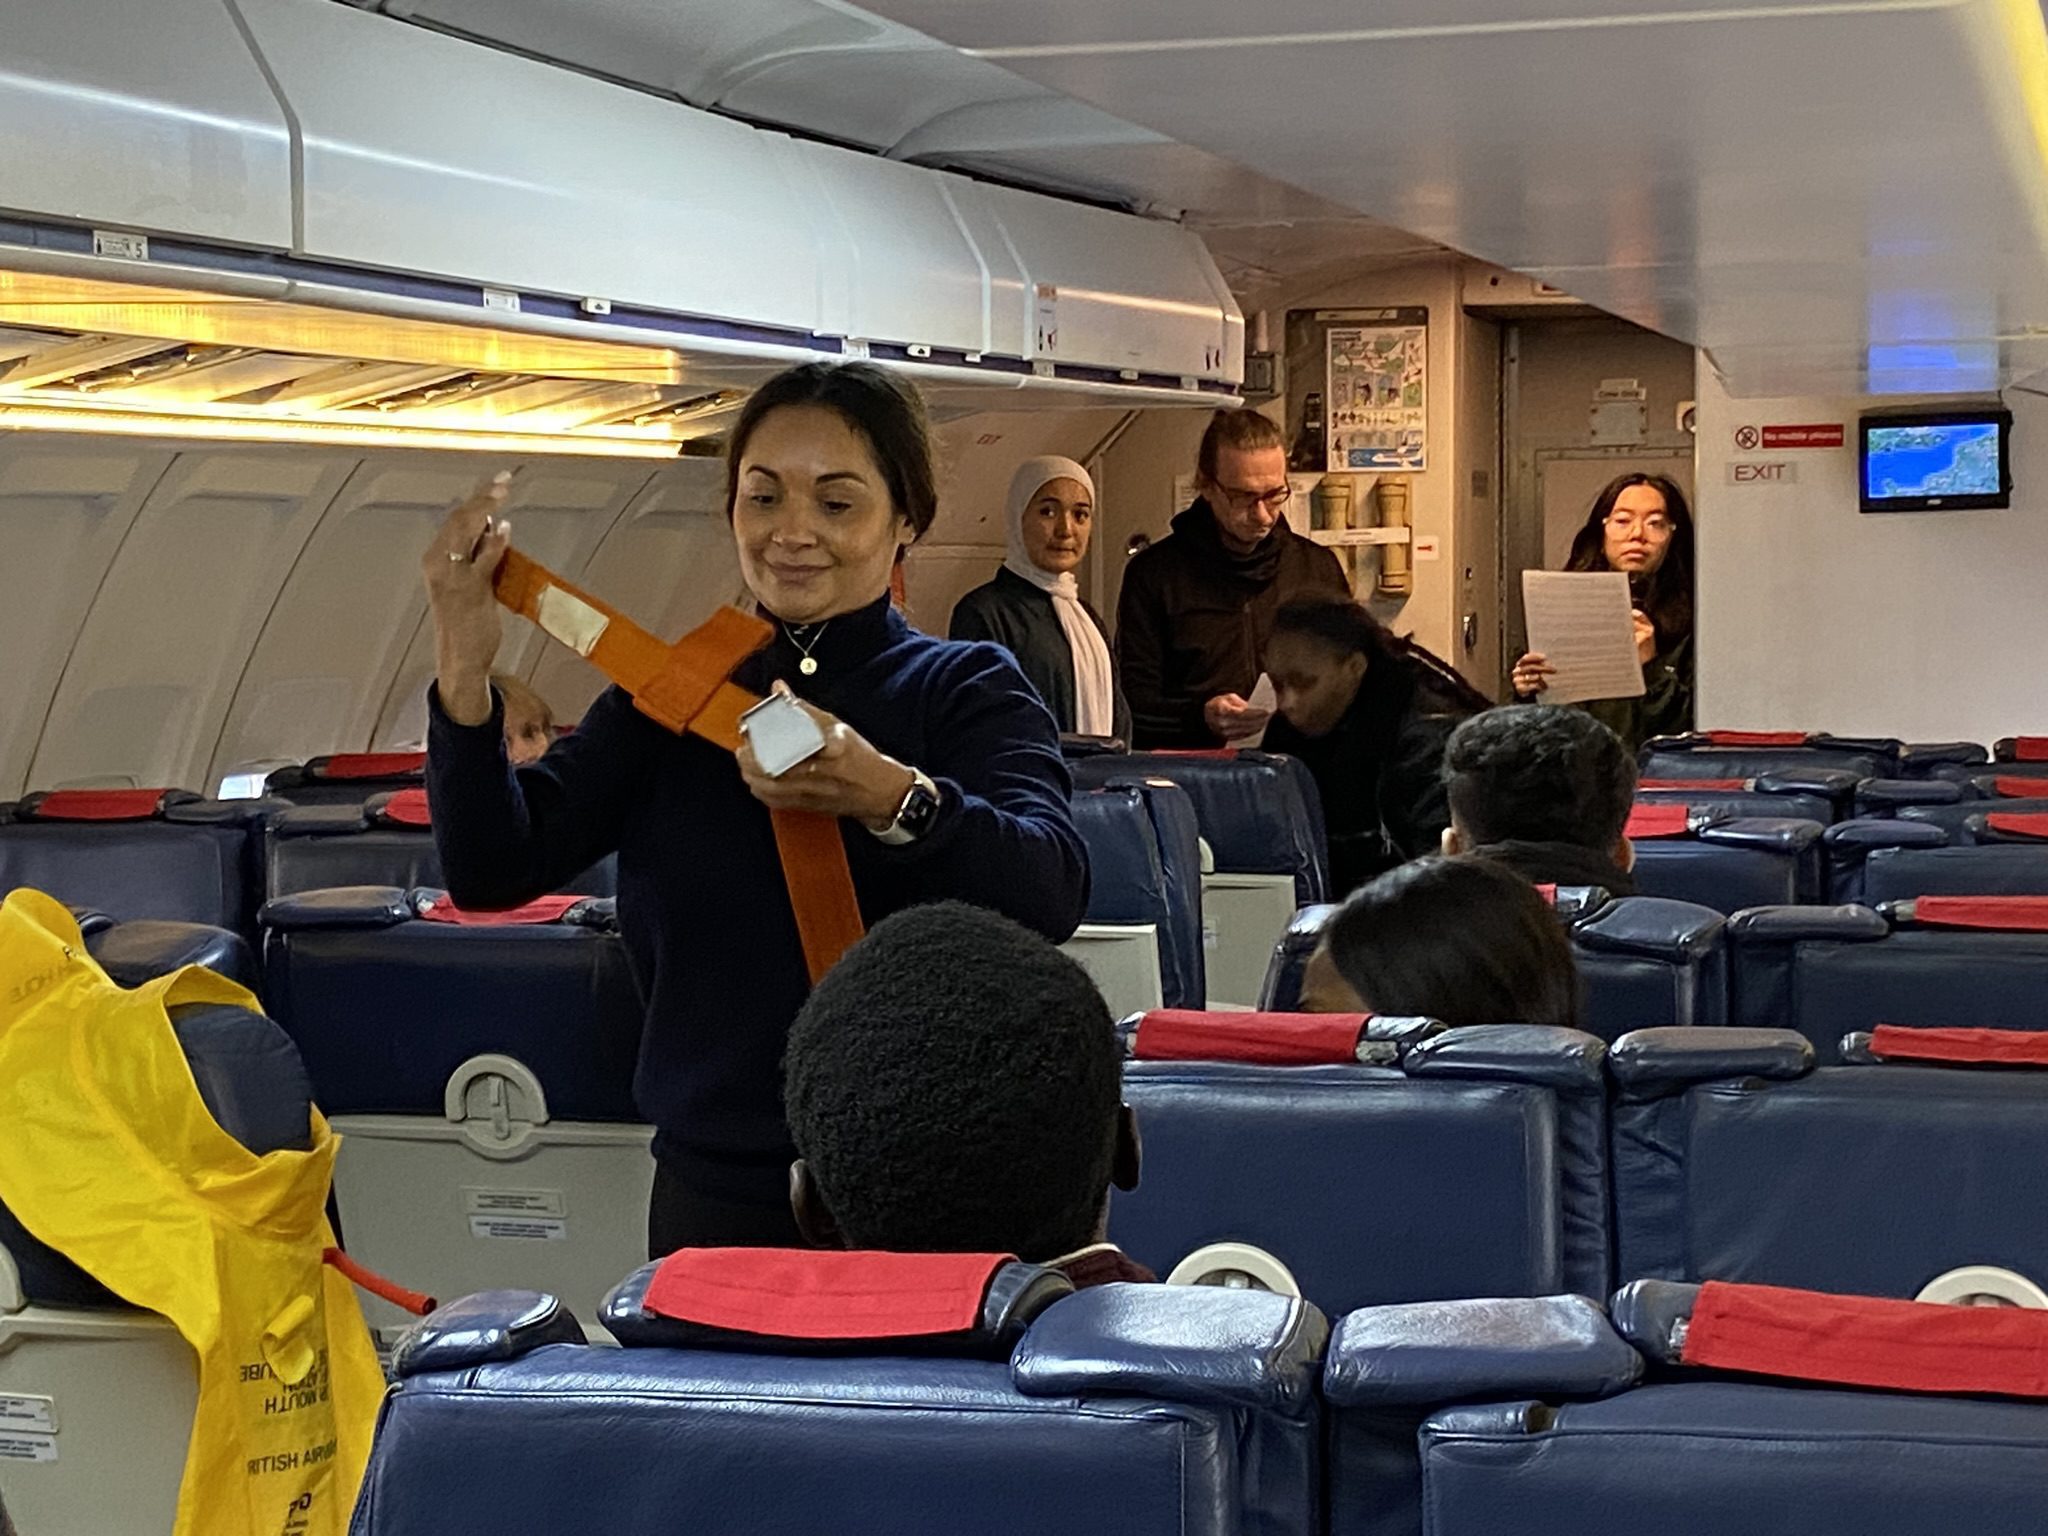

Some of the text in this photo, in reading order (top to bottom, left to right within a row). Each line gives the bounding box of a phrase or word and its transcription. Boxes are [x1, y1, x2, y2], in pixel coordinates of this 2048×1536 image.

[1735, 464, 1786, 481] EXIT
[240, 1362, 275, 1382] UBE
[246, 1452, 299, 1475] RITISH
